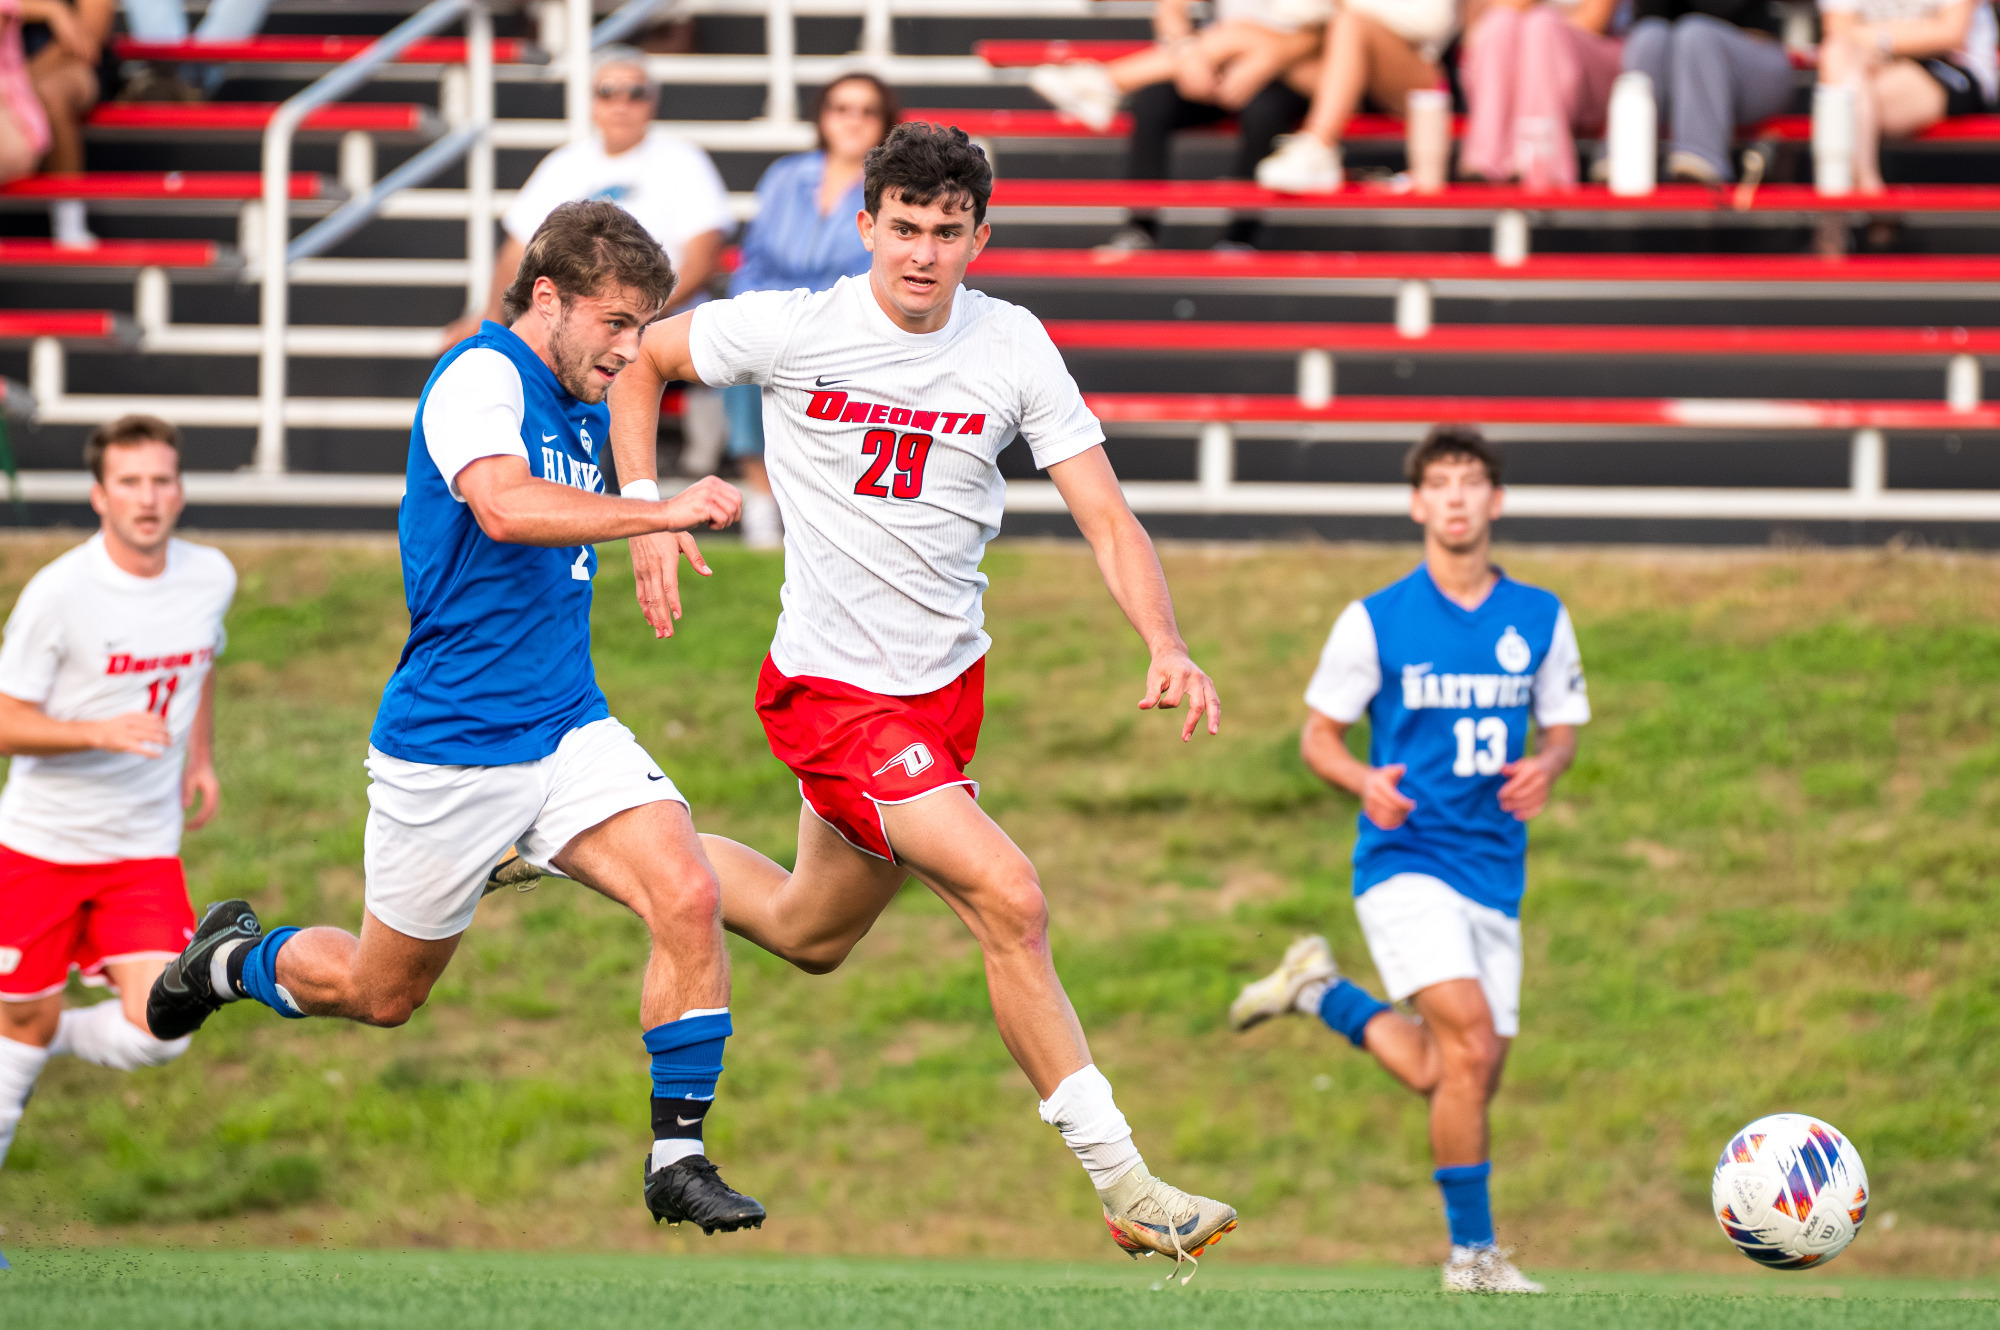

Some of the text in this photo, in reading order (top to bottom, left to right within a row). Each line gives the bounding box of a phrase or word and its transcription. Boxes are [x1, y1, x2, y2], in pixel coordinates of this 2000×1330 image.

[799, 389, 986, 435] ONEONTA
[853, 428, 934, 499] 29
[1452, 716, 1508, 777] 13
